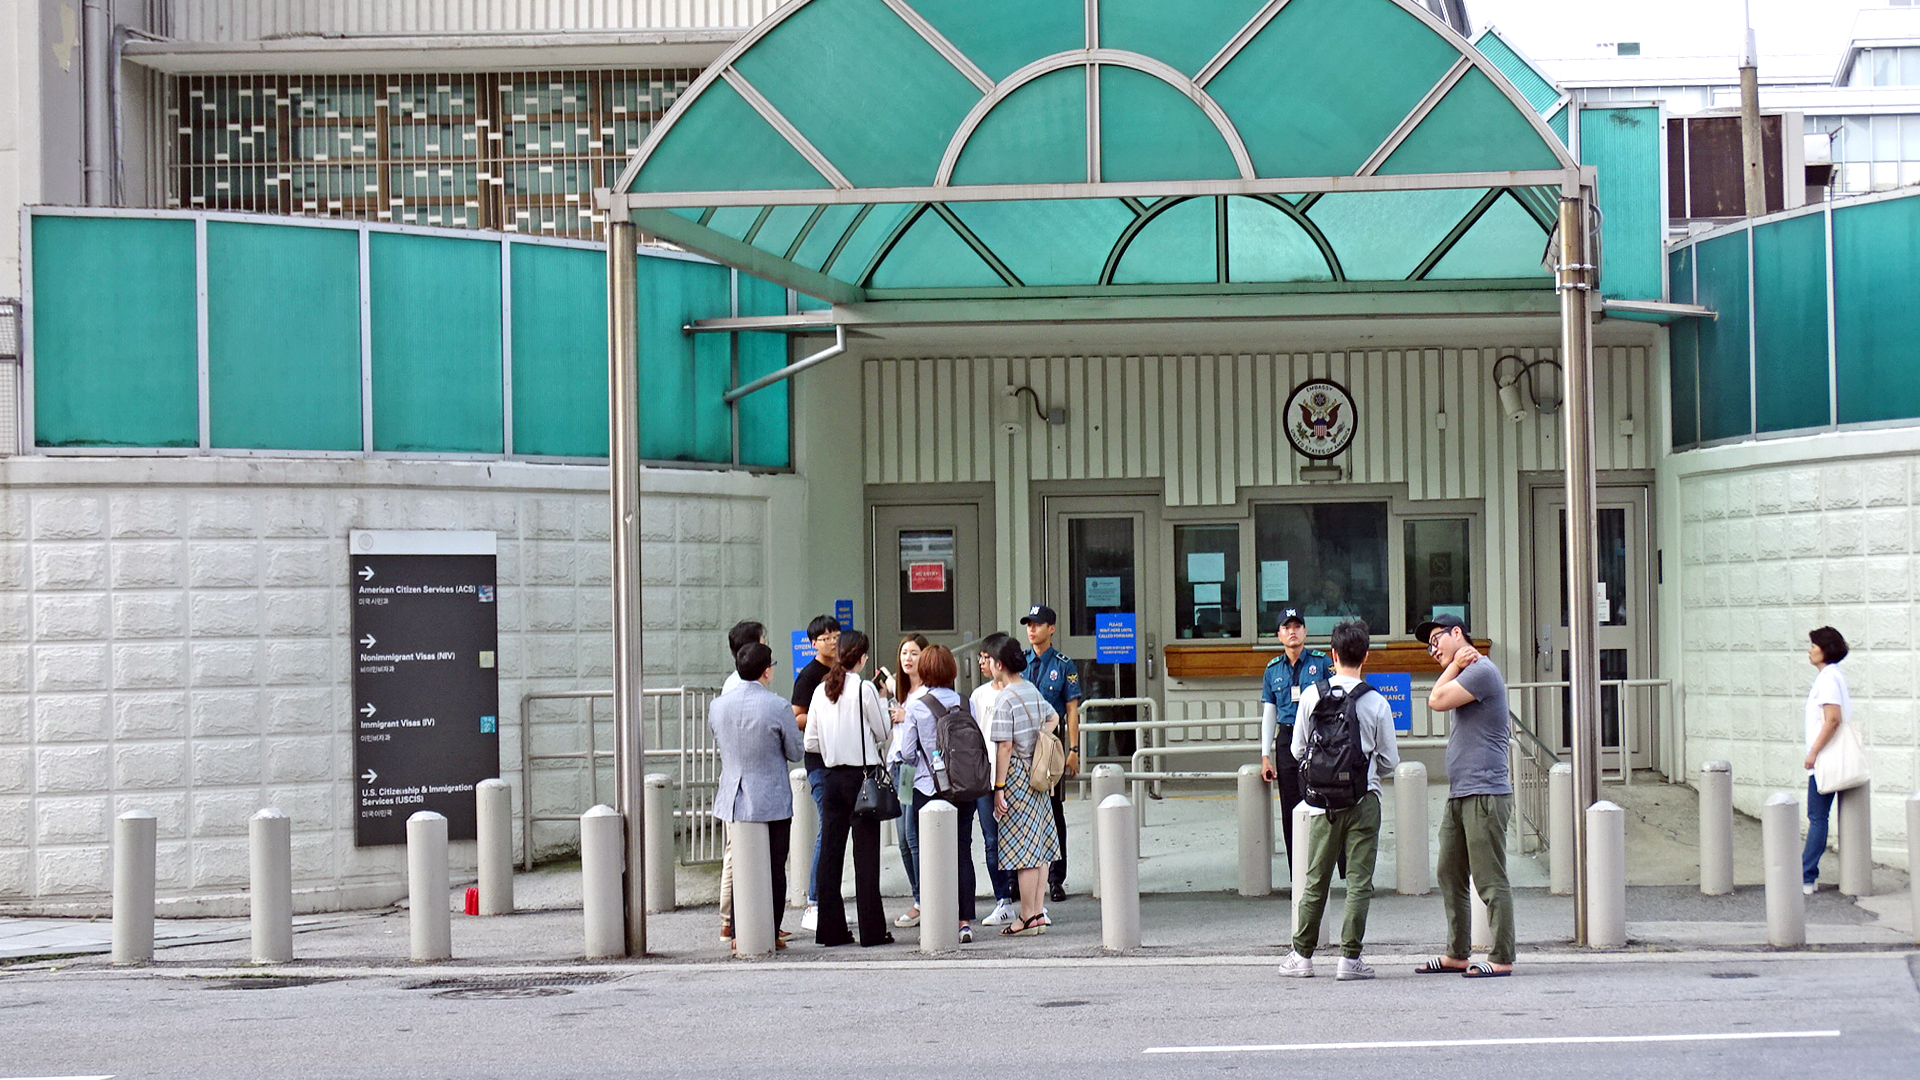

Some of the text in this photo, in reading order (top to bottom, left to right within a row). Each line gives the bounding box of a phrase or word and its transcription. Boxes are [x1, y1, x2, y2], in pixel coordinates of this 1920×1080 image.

[1306, 385, 1333, 393] EMBASSY
[1290, 429, 1304, 447] UNITED
[1305, 445, 1326, 454] STATES
[1334, 428, 1351, 449] AMERICA
[358, 585, 476, 594] American Citizen Services (ACS)
[360, 652, 456, 663] Nonimmigrant Visas (NIV)
[360, 718, 435, 729] Immigrant Visas (IV)
[362, 789, 377, 797] U.S.
[379, 787, 419, 796] Citizenship
[429, 784, 473, 793] Immigration
[362, 796, 424, 806] Services (USCIS)
